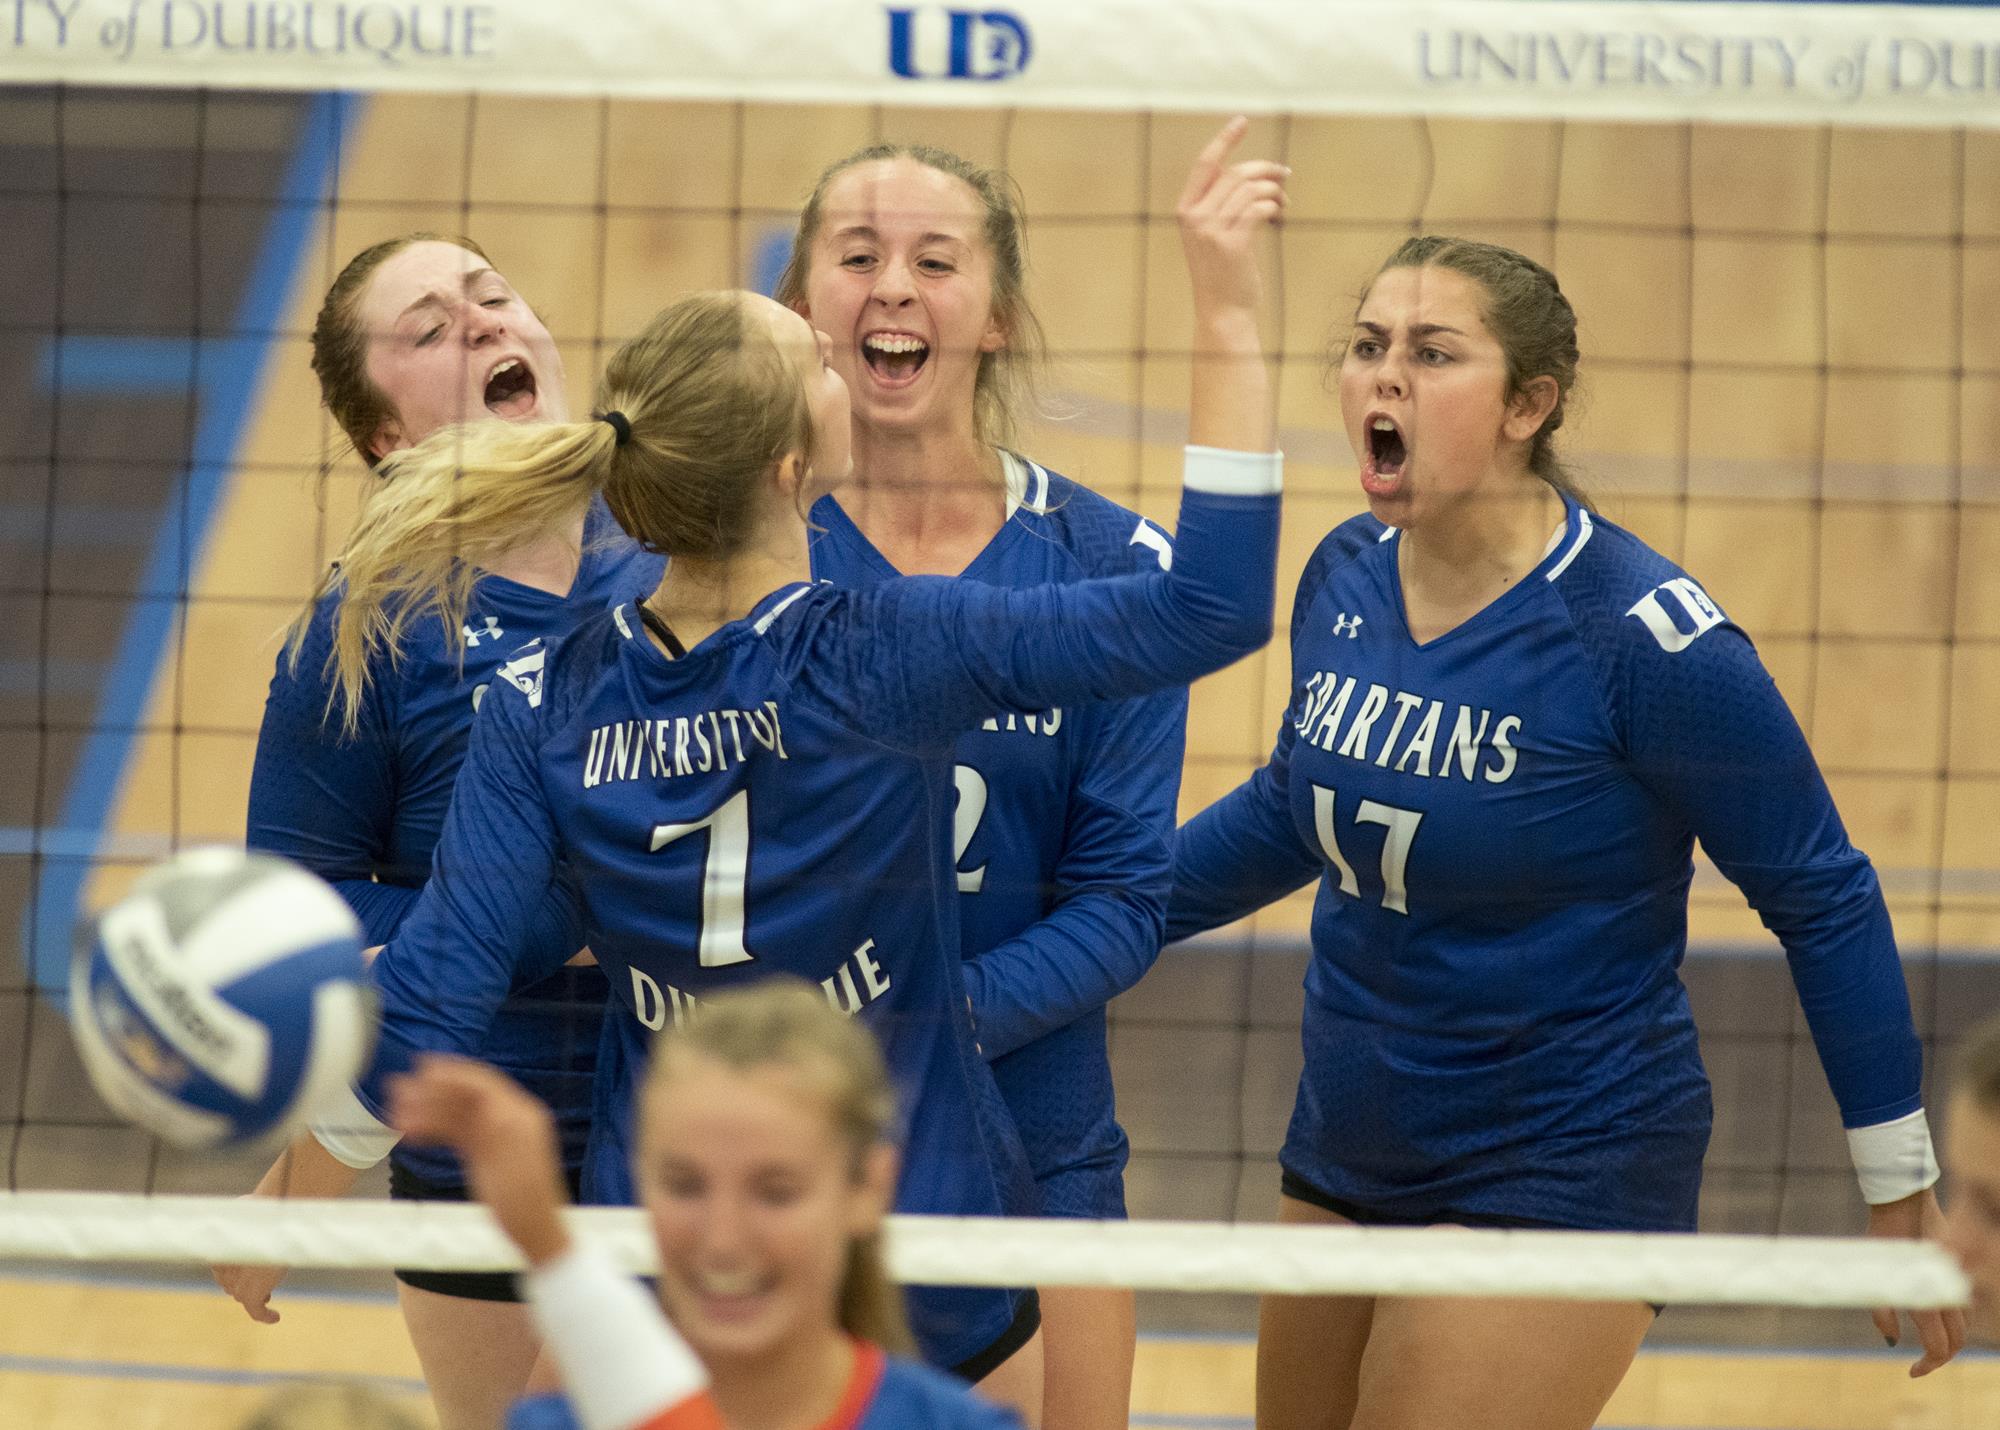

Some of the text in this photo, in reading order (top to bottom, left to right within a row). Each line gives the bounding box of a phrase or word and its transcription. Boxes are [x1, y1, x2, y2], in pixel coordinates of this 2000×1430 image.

[98, 0, 143, 62] of
[161, 0, 498, 68] DUBUQUE
[1418, 30, 2000, 100] UNIVERSITY of DU
[1295, 671, 1522, 784] SPARTANS
[650, 788, 754, 968] 7
[1311, 784, 1424, 916] 17
[628, 937, 891, 1032] DUUE
